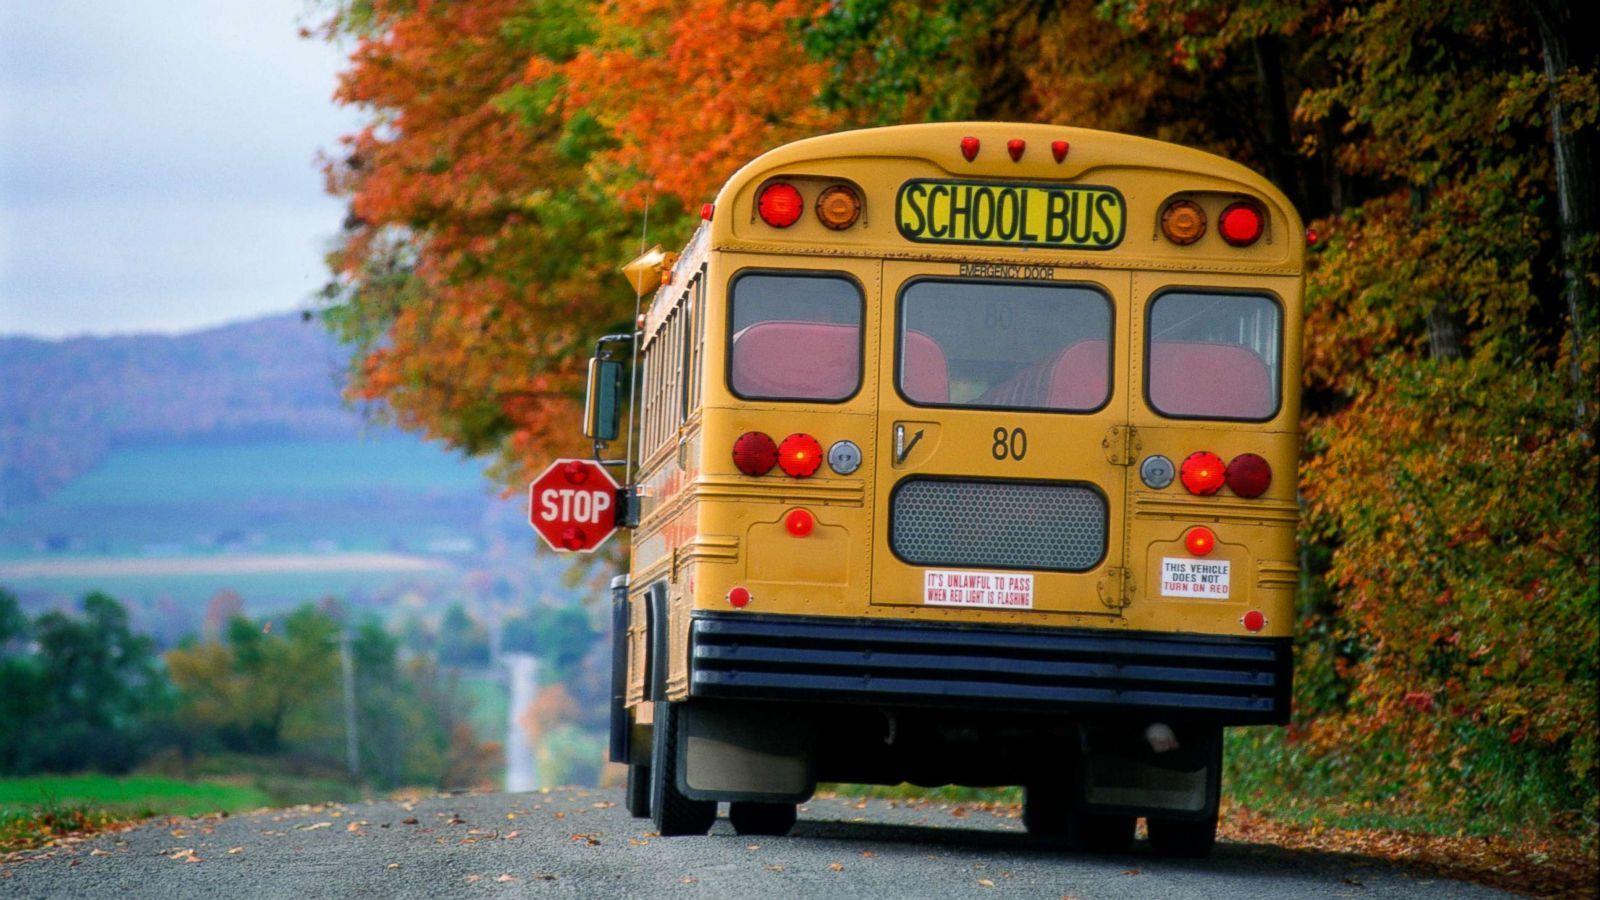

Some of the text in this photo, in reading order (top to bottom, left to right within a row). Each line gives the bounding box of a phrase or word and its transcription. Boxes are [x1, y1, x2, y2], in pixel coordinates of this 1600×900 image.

[904, 184, 1116, 245] SCHOOL BUS
[959, 263, 1054, 280] EMERGENCY DOOR
[992, 427, 1027, 461] 80
[541, 489, 610, 523] STOP
[1165, 563, 1228, 574] THIS VEHICLE
[928, 573, 1030, 591] IT'S UNLAWFUL TO PASS
[1172, 573, 1219, 583] DOES NOT
[1164, 582, 1228, 593] TURN ON RED
[928, 589, 1030, 606] WHEN RED LIGHT IS FLASHING
